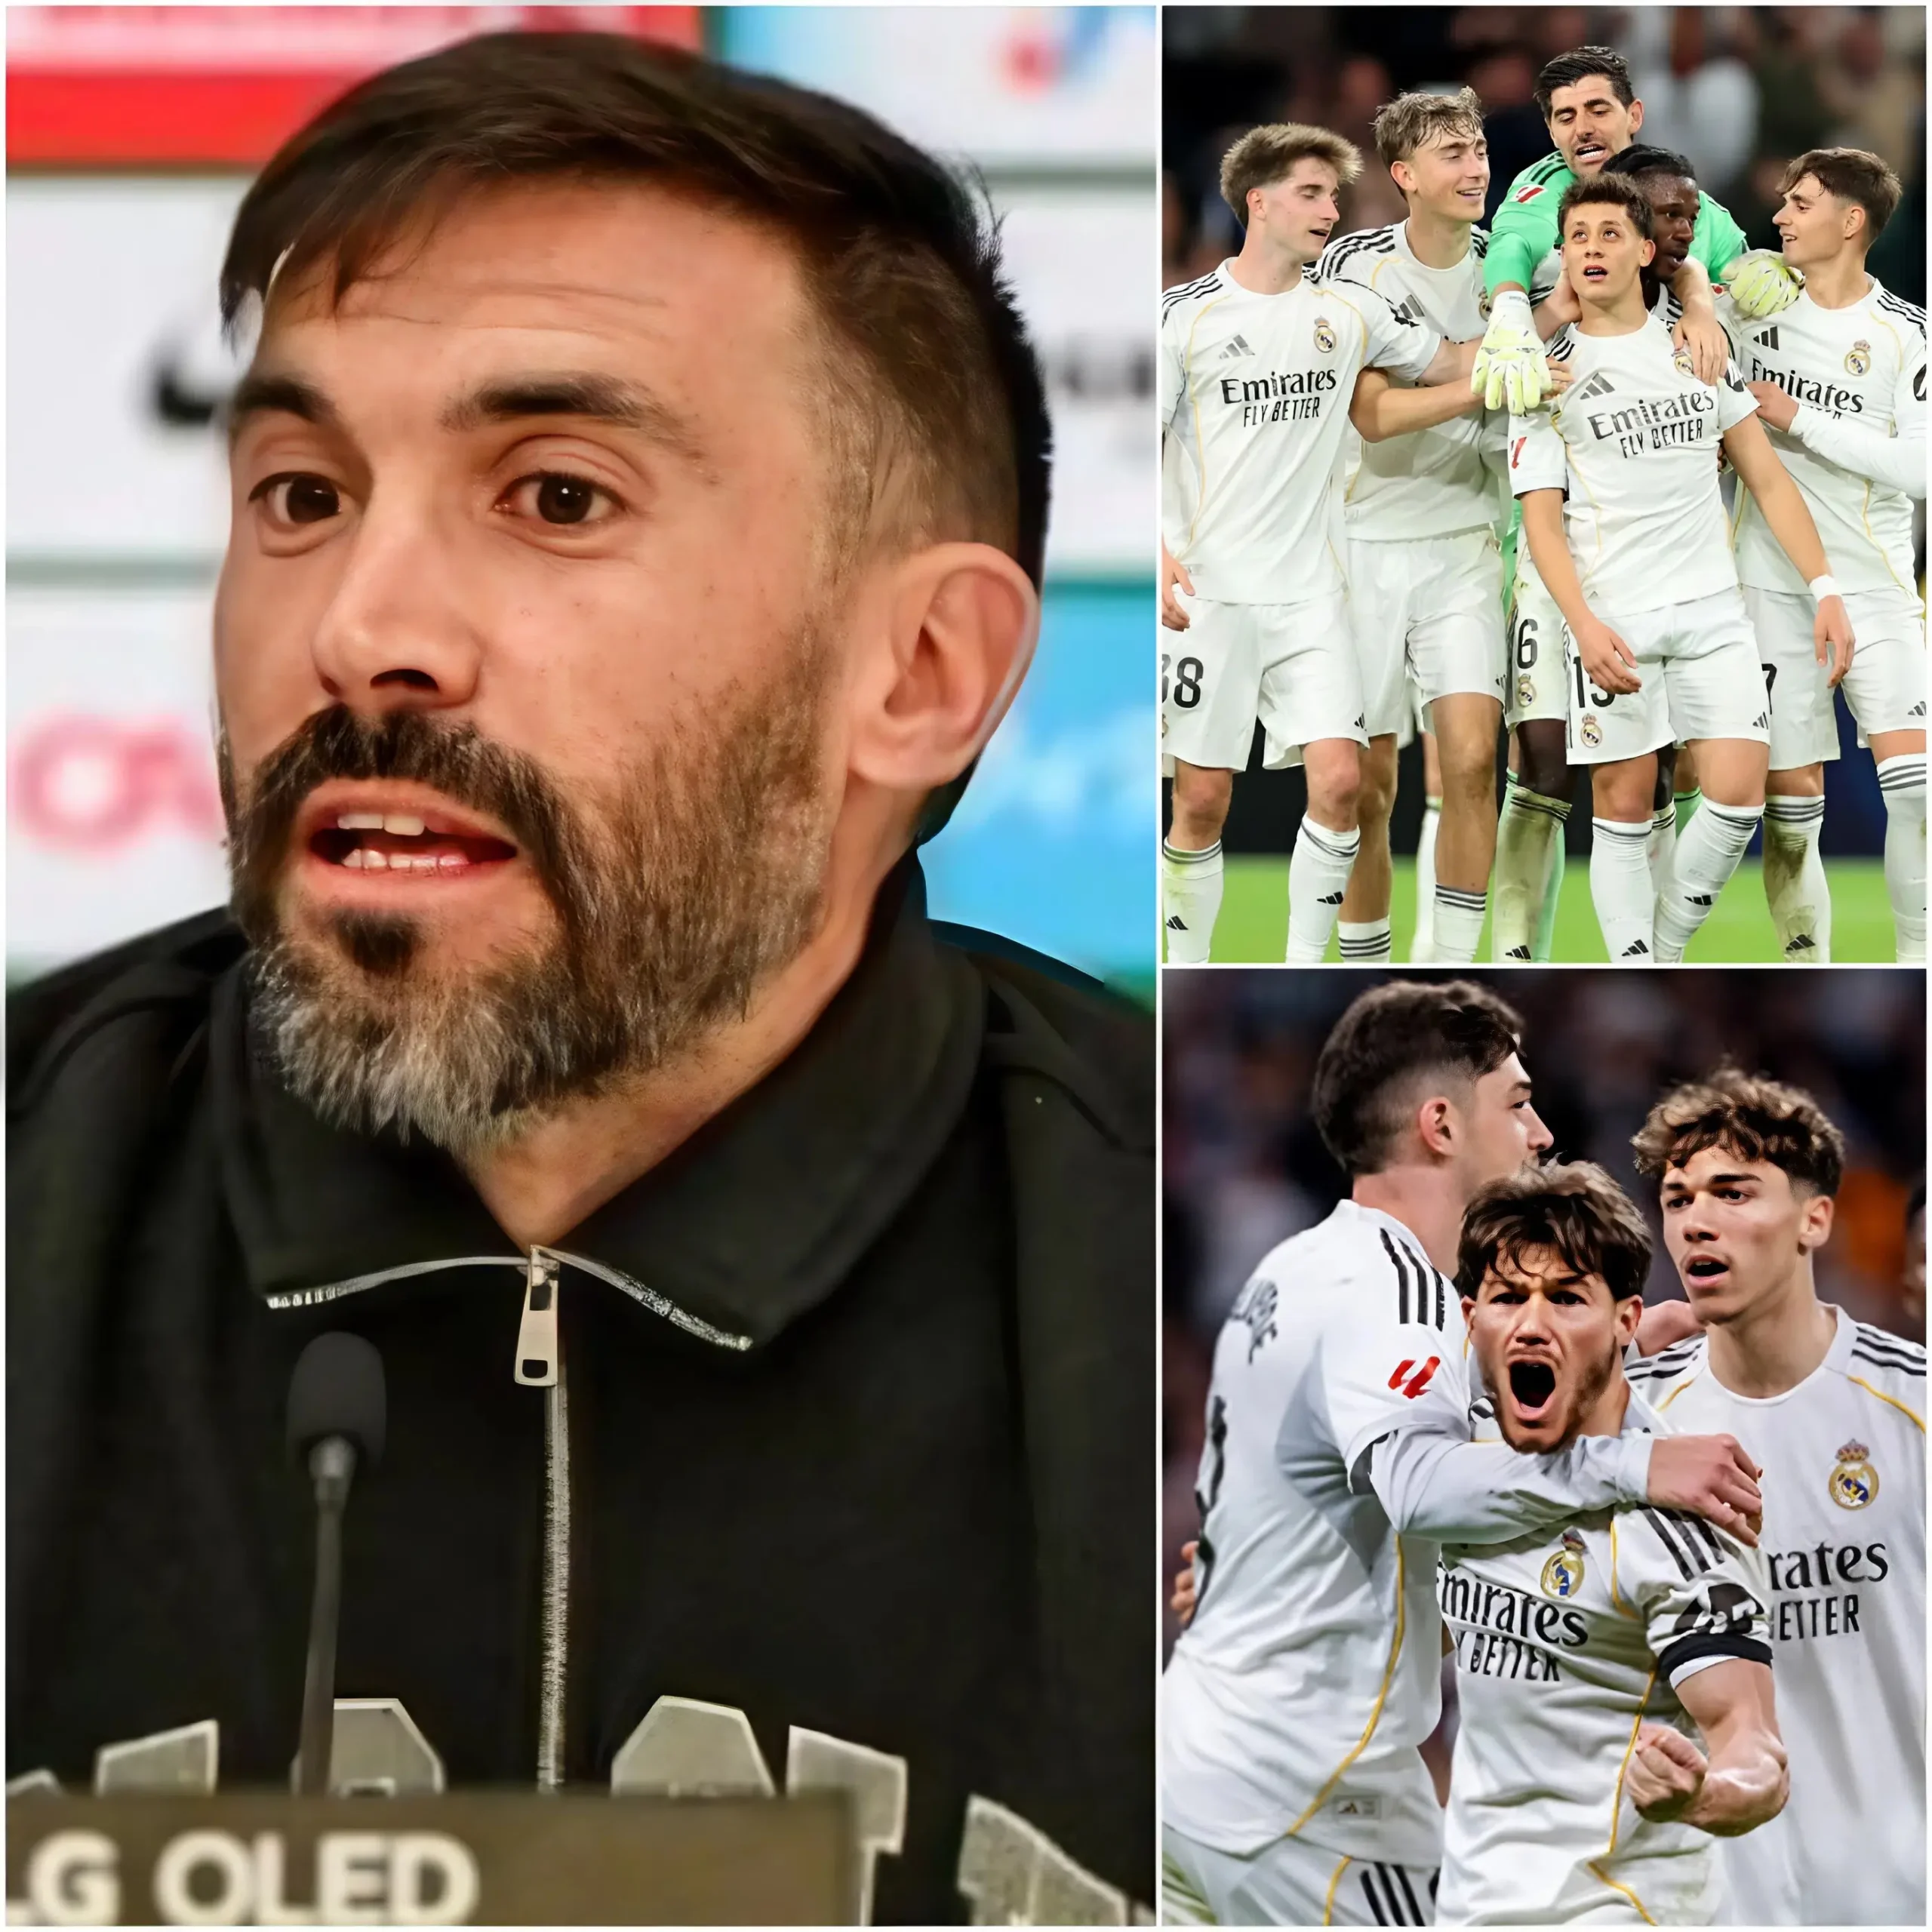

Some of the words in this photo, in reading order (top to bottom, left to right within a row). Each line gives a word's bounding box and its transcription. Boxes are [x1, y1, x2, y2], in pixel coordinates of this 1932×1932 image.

[1220, 369, 1337, 404] Emirates
[1752, 357, 1864, 413] Emirates
[1244, 405, 1269, 427] FLY
[1271, 397, 1320, 421] BETTER
[1587, 390, 1714, 440] Emirates
[1620, 432, 1644, 459] FLY
[1651, 418, 1703, 449] BETTER
[1517, 618, 1538, 669] 6
[1437, 1571, 1588, 1647] mirates
[1768, 1594, 1860, 1641] ETTER
[155, 1829, 481, 1926] OLED
